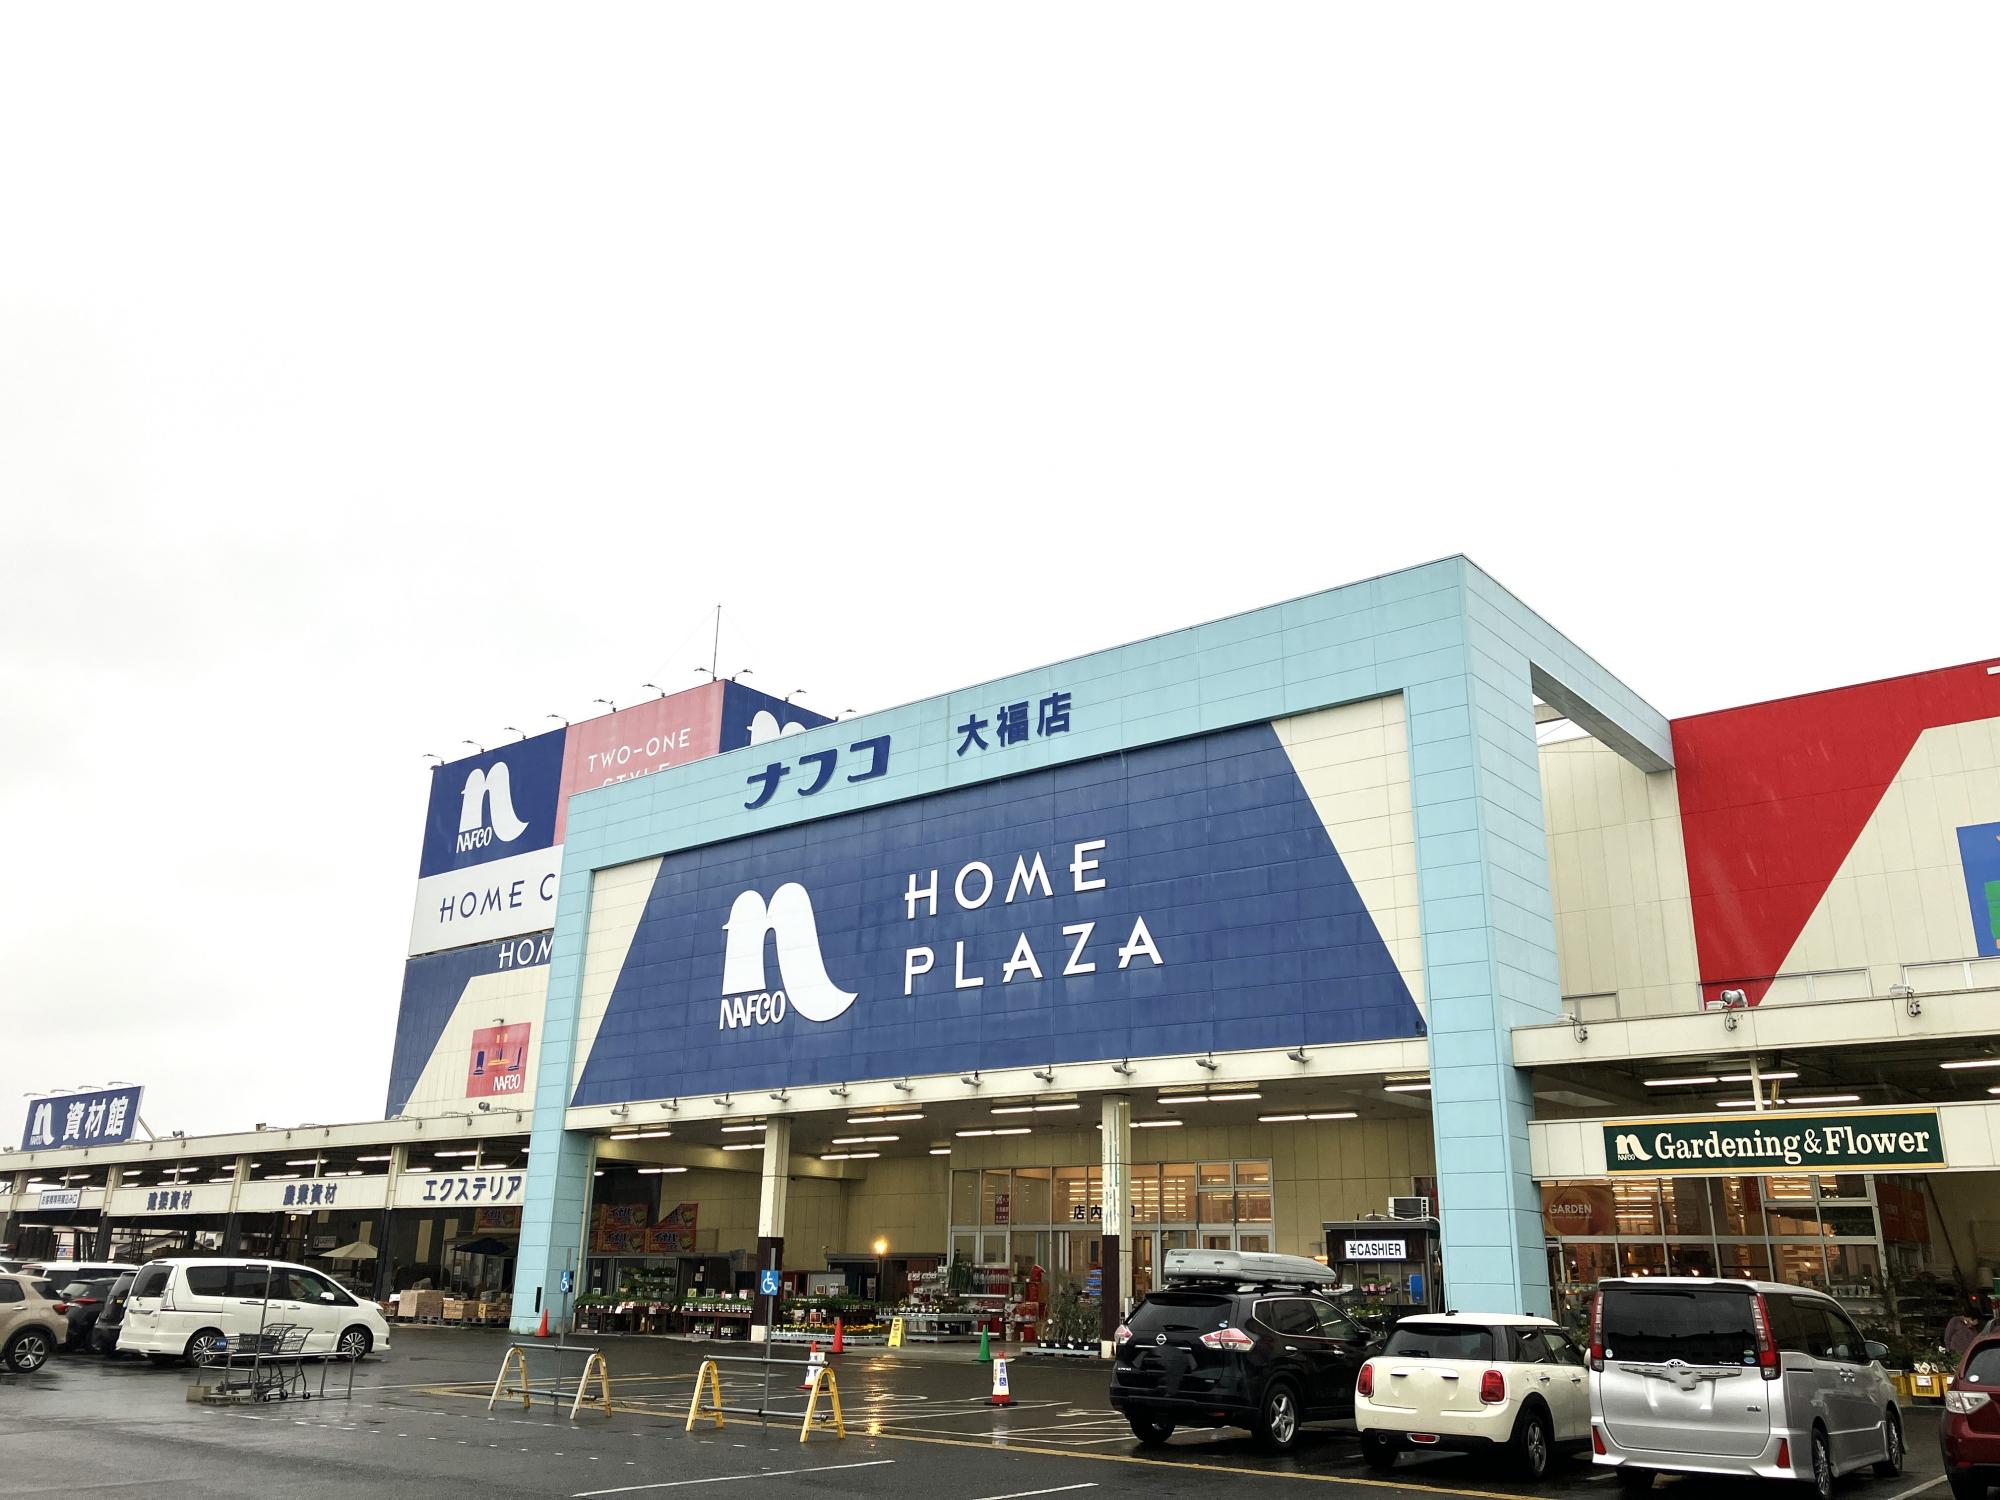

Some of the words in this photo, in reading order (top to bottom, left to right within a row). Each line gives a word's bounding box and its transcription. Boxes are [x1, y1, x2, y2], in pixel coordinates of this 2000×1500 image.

[588, 728, 691, 773] TWO-ONE
[744, 734, 891, 809] ナフコ
[956, 691, 1072, 756] 大福店
[456, 826, 492, 853] NAFCO
[904, 839, 1106, 919] HOME
[440, 880, 525, 923] HOME
[904, 915, 1164, 996] PLAZA
[719, 990, 786, 1030] NAFCO
[493, 1073, 521, 1091] NAFCO
[63, 1096, 129, 1141] 資材館
[423, 1175, 522, 1202] エクステリア
[1549, 1204, 1592, 1214] GARDEN
